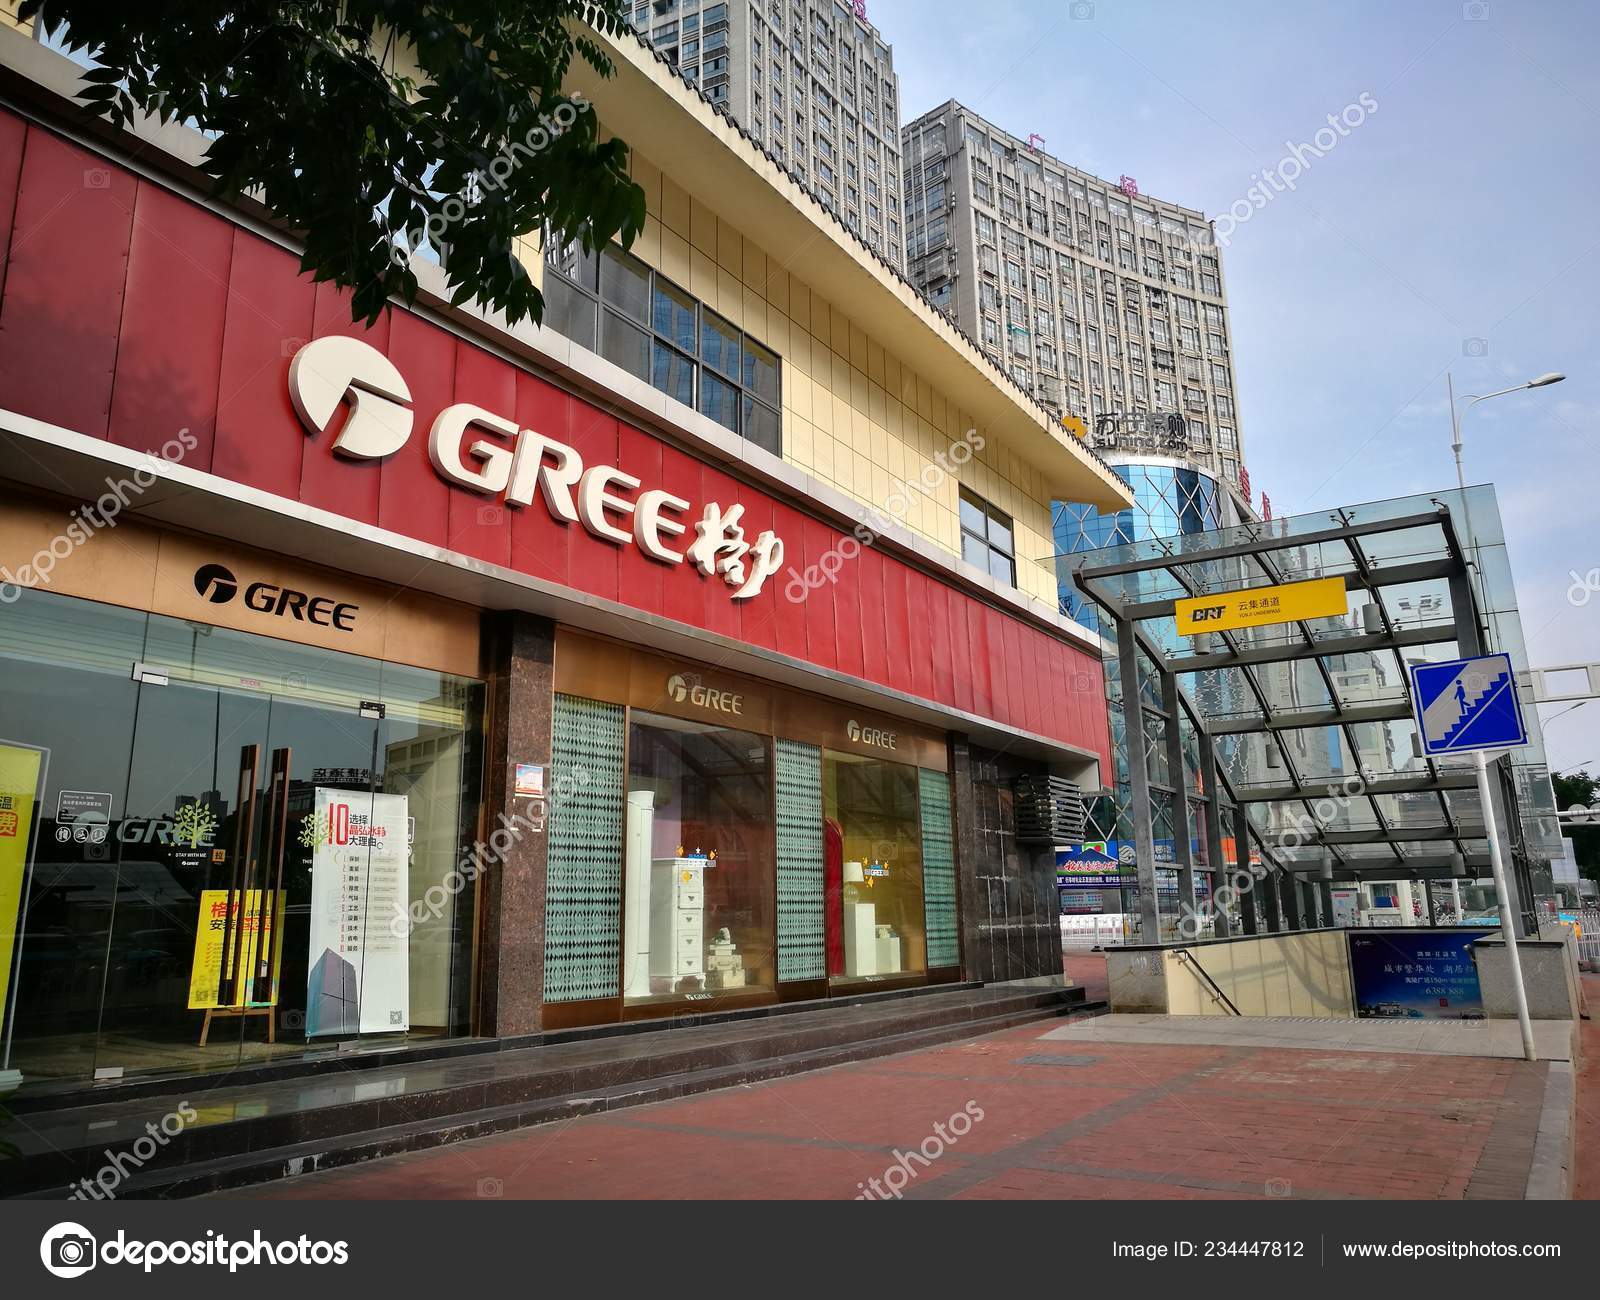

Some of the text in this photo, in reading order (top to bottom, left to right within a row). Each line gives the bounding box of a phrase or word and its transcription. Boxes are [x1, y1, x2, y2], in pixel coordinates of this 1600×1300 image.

[428, 402, 690, 565] GREE
[687, 501, 785, 600] 格力
[245, 582, 359, 632] GREE
[1238, 596, 1280, 611] 云集通道
[690, 687, 743, 715] GREE
[862, 727, 897, 750] GREE
[328, 803, 349, 846] 10
[350, 814, 368, 825] 选择
